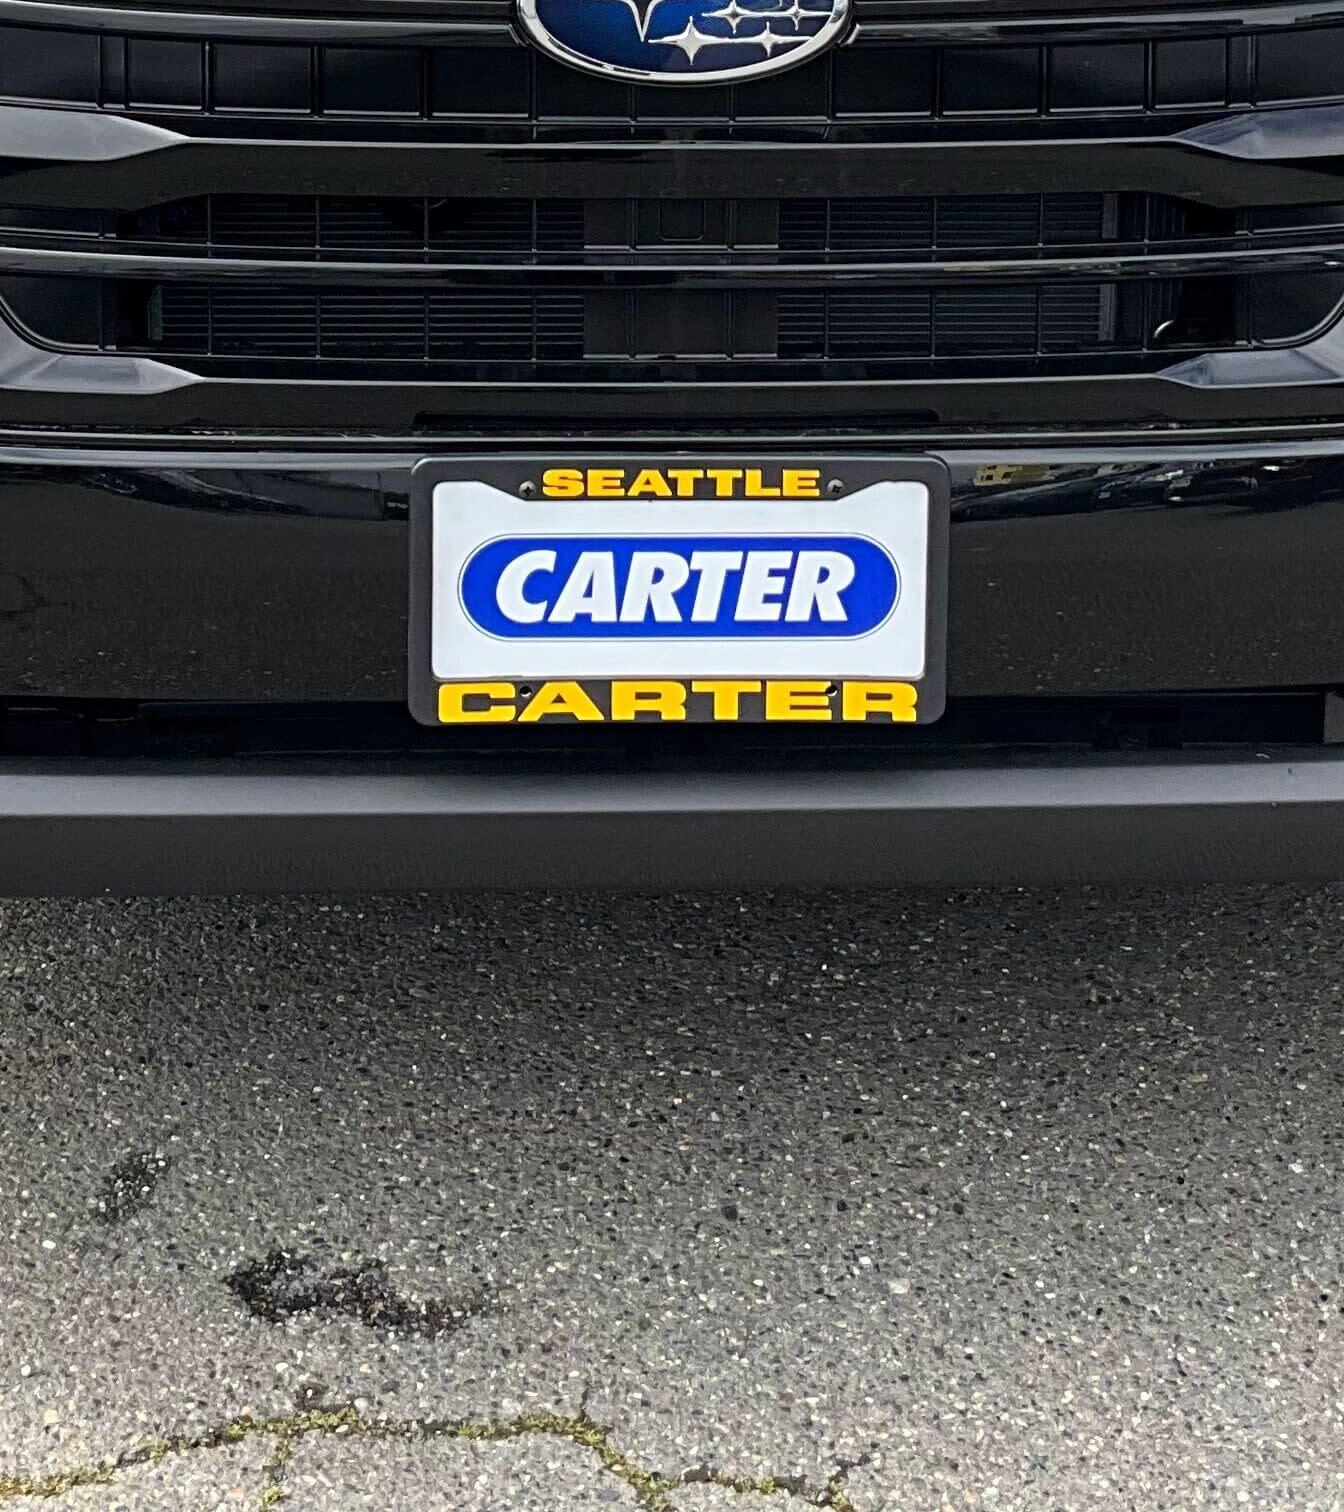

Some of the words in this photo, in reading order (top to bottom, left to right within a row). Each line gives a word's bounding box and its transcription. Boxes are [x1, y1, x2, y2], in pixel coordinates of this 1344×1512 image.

[541, 468, 821, 498] SEATTLE
[495, 548, 855, 624] CARTER
[437, 680, 918, 723] CARTER
